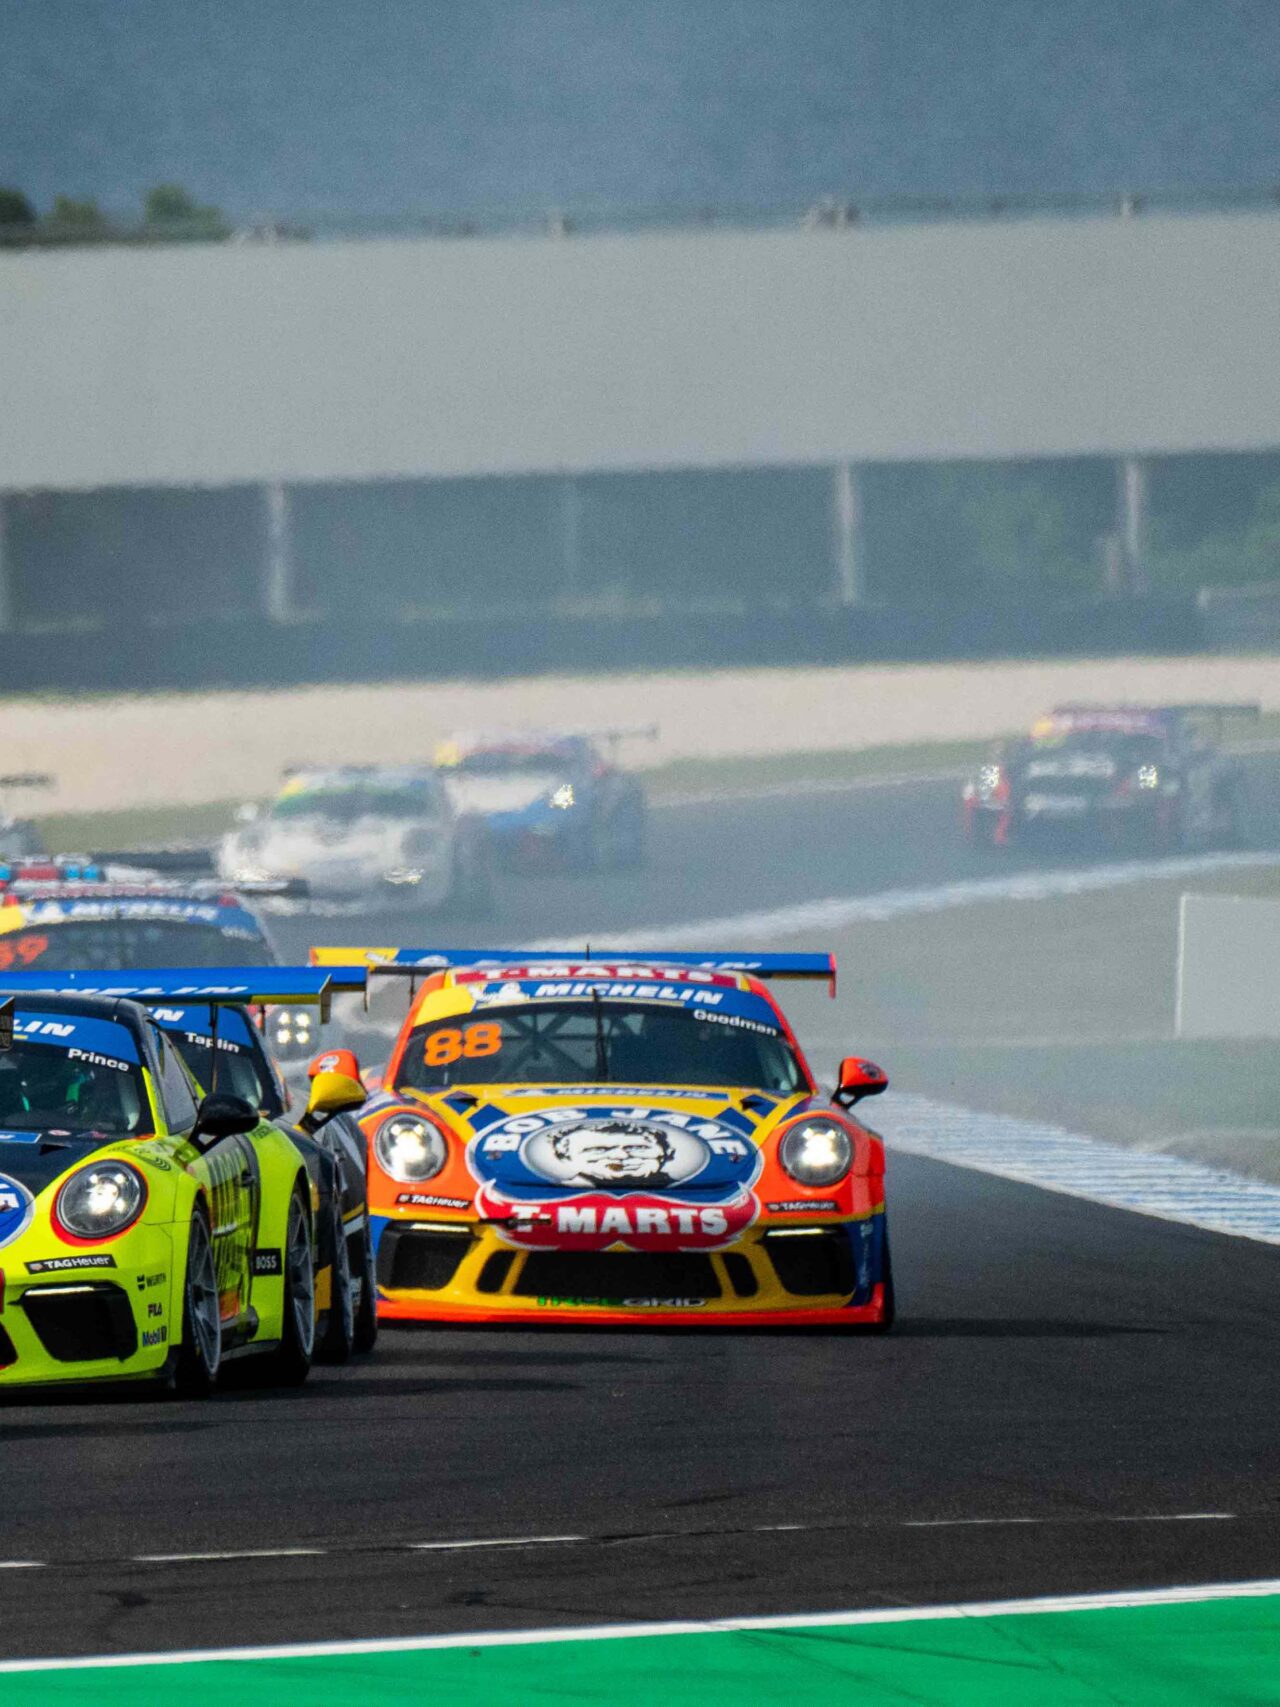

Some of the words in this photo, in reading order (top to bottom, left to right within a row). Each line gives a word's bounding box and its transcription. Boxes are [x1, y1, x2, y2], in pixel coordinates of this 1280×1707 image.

[535, 983, 724, 1006] MICHELIN
[692, 1008, 778, 1036] Goodman
[185, 1031, 240, 1054] Taplin
[425, 1022, 503, 1068] 88
[67, 1048, 131, 1072] Prince
[483, 1108, 588, 1151] BOB
[611, 1107, 748, 1156] JANE
[508, 1204, 729, 1235] T-MARTS
[255, 1255, 277, 1270] BOSS
